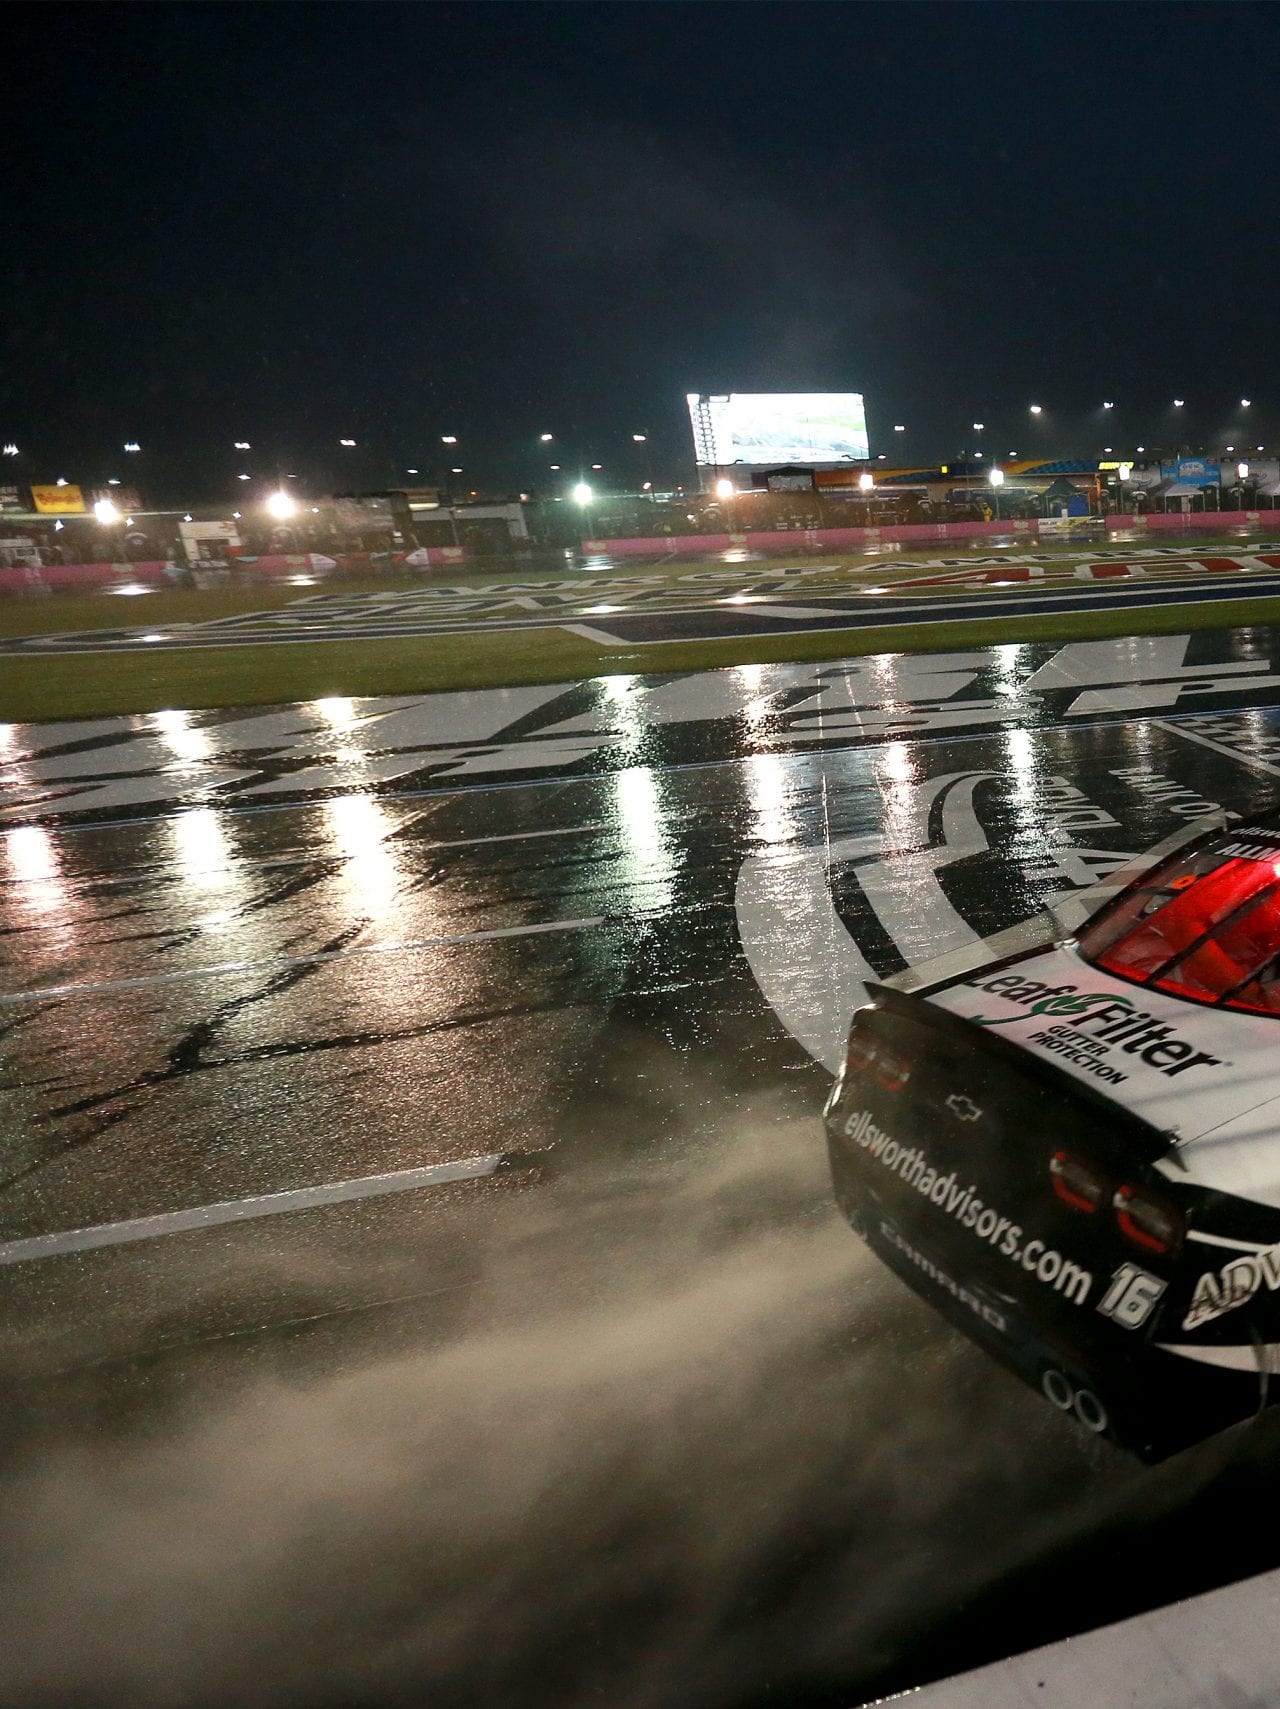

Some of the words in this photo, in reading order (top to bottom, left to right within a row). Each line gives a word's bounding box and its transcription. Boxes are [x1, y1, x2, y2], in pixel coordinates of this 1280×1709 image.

[287, 575, 678, 606] BANK
[677, 566, 840, 582] OF
[963, 967, 1078, 1005] Leaf
[1067, 1003, 1223, 1079] Filter
[1047, 1024, 1108, 1062] GUTTER
[1026, 1031, 1128, 1086] PROTECTION
[844, 1111, 1093, 1306] ellsworthadvisors.com
[1097, 1262, 1169, 1330] 16
